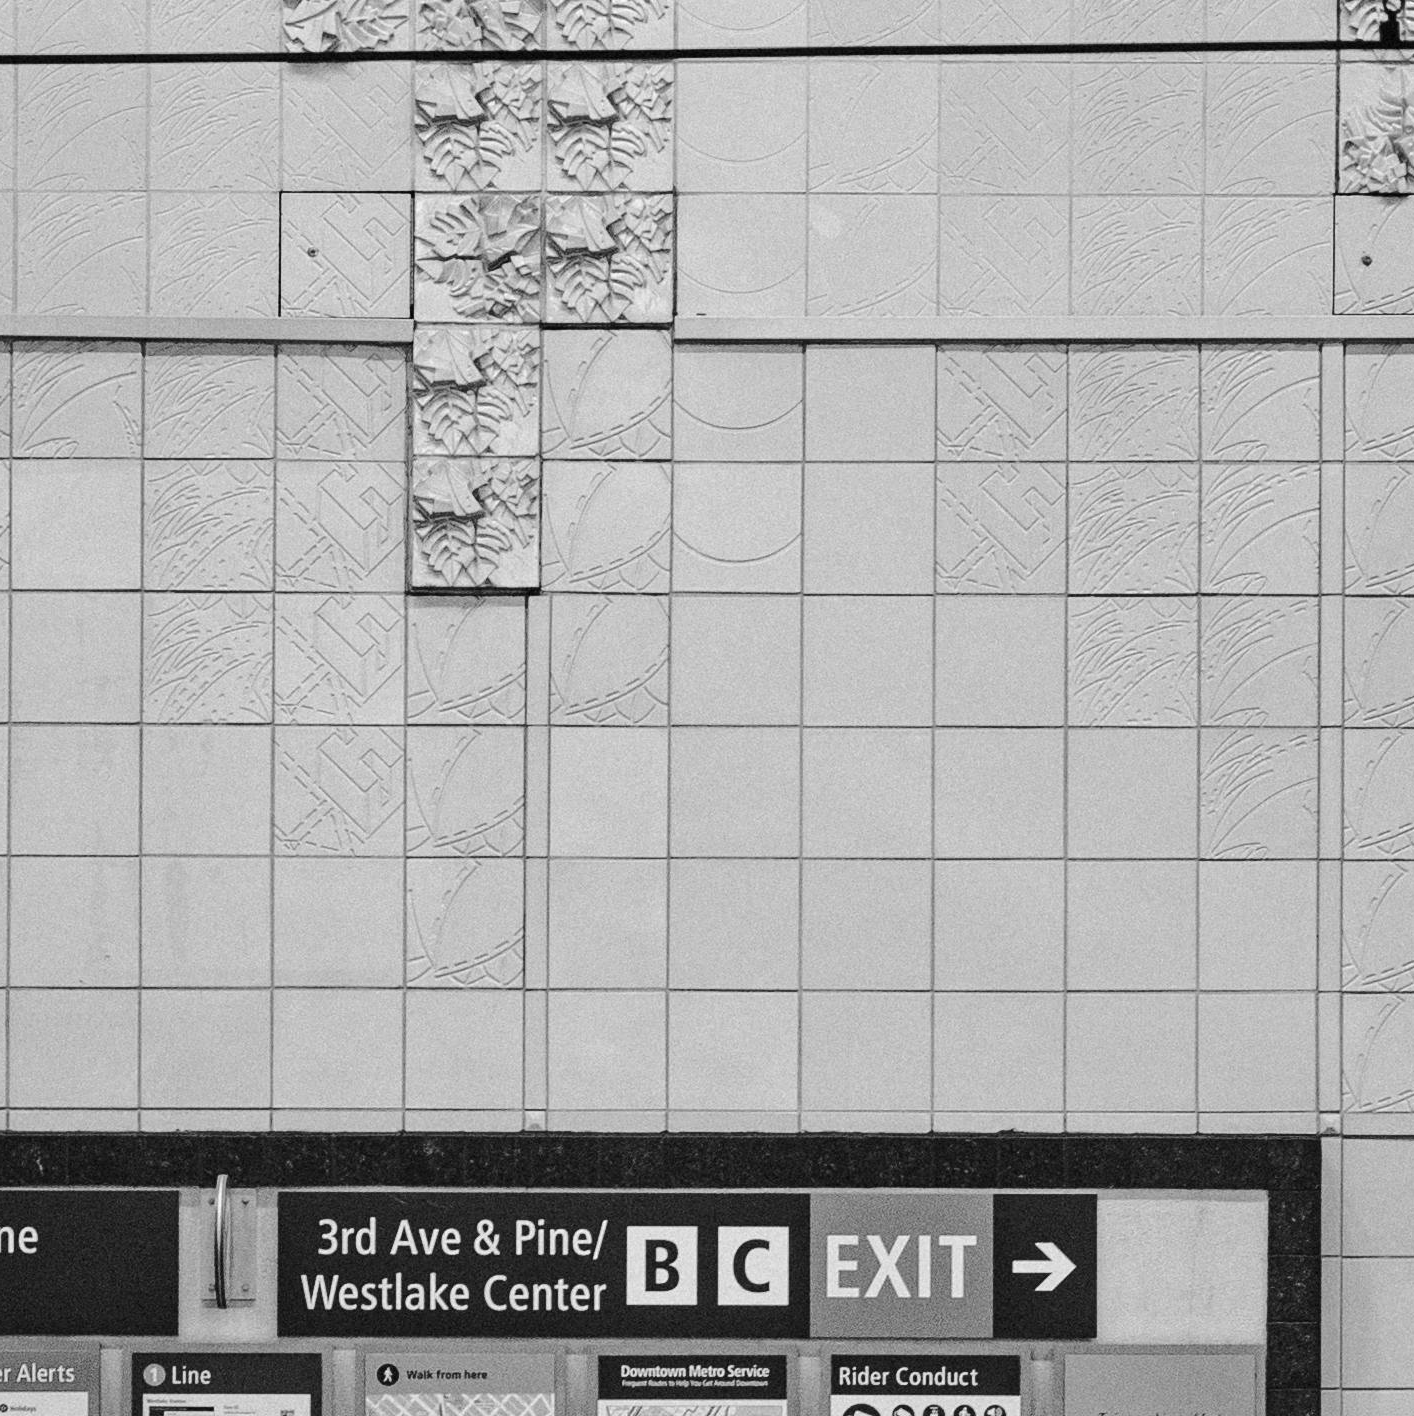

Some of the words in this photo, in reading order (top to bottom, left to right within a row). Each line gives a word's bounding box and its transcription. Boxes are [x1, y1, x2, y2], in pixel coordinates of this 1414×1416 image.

[318, 1217, 376, 1255] 3rd
[390, 1220, 461, 1255] Ave
[474, 1219, 500, 1255] &
[516, 1219, 608, 1260] Pine/
[646, 1240, 679, 1291] B
[733, 1239, 769, 1293] C
[827, 1235, 977, 1298] EXIT
[301, 1272, 469, 1310] Westlake
[484, 1275, 606, 1311] Center
[17, 1363, 74, 1382] Alerts
[172, 1366, 211, 1384] Line
[407, 1369, 432, 1380] Walk
[437, 1369, 461, 1380] from
[464, 1369, 487, 1380] here
[621, 1365, 687, 1377] Downtown
[689, 1365, 725, 1377] Metro
[727, 1364, 770, 1377] Service
[839, 1366, 889, 1385] Rider
[896, 1366, 978, 1386] Conduct
